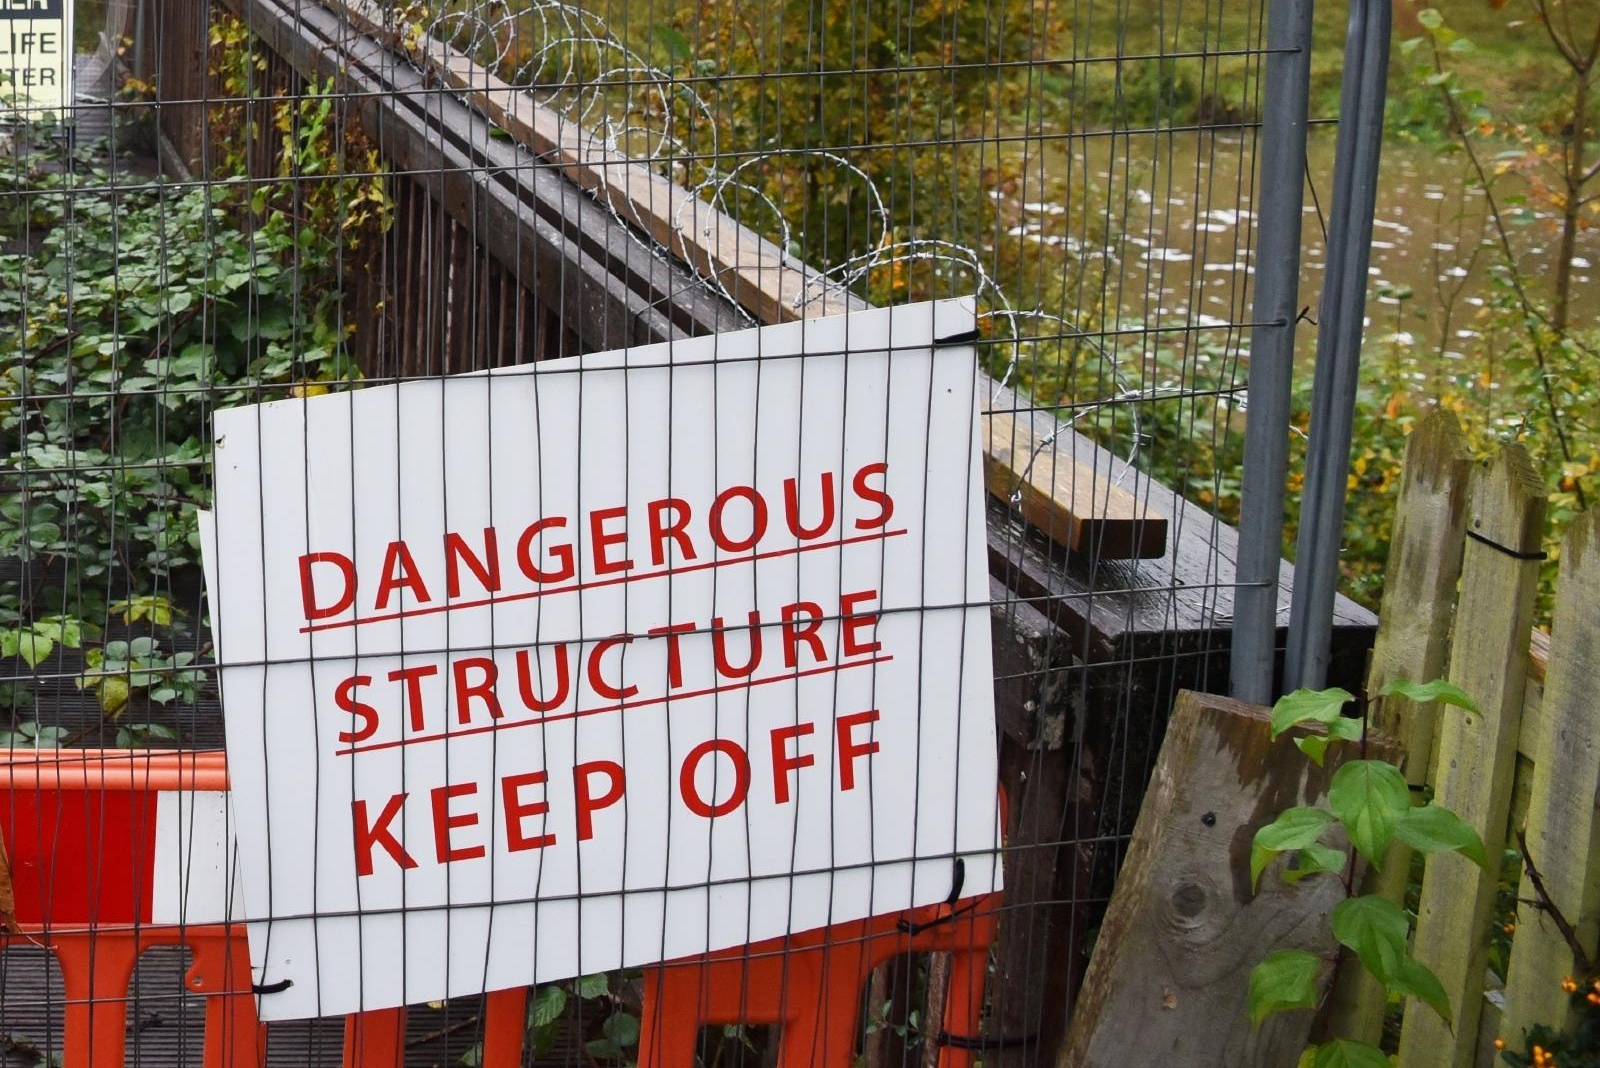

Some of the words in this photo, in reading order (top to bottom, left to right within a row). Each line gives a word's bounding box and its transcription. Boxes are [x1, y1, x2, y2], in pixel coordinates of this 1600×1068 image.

[298, 463, 896, 621] DANGEROUS
[335, 591, 883, 742] STRUCTURE
[351, 761, 626, 877] KEEP
[679, 710, 880, 818] OFF
